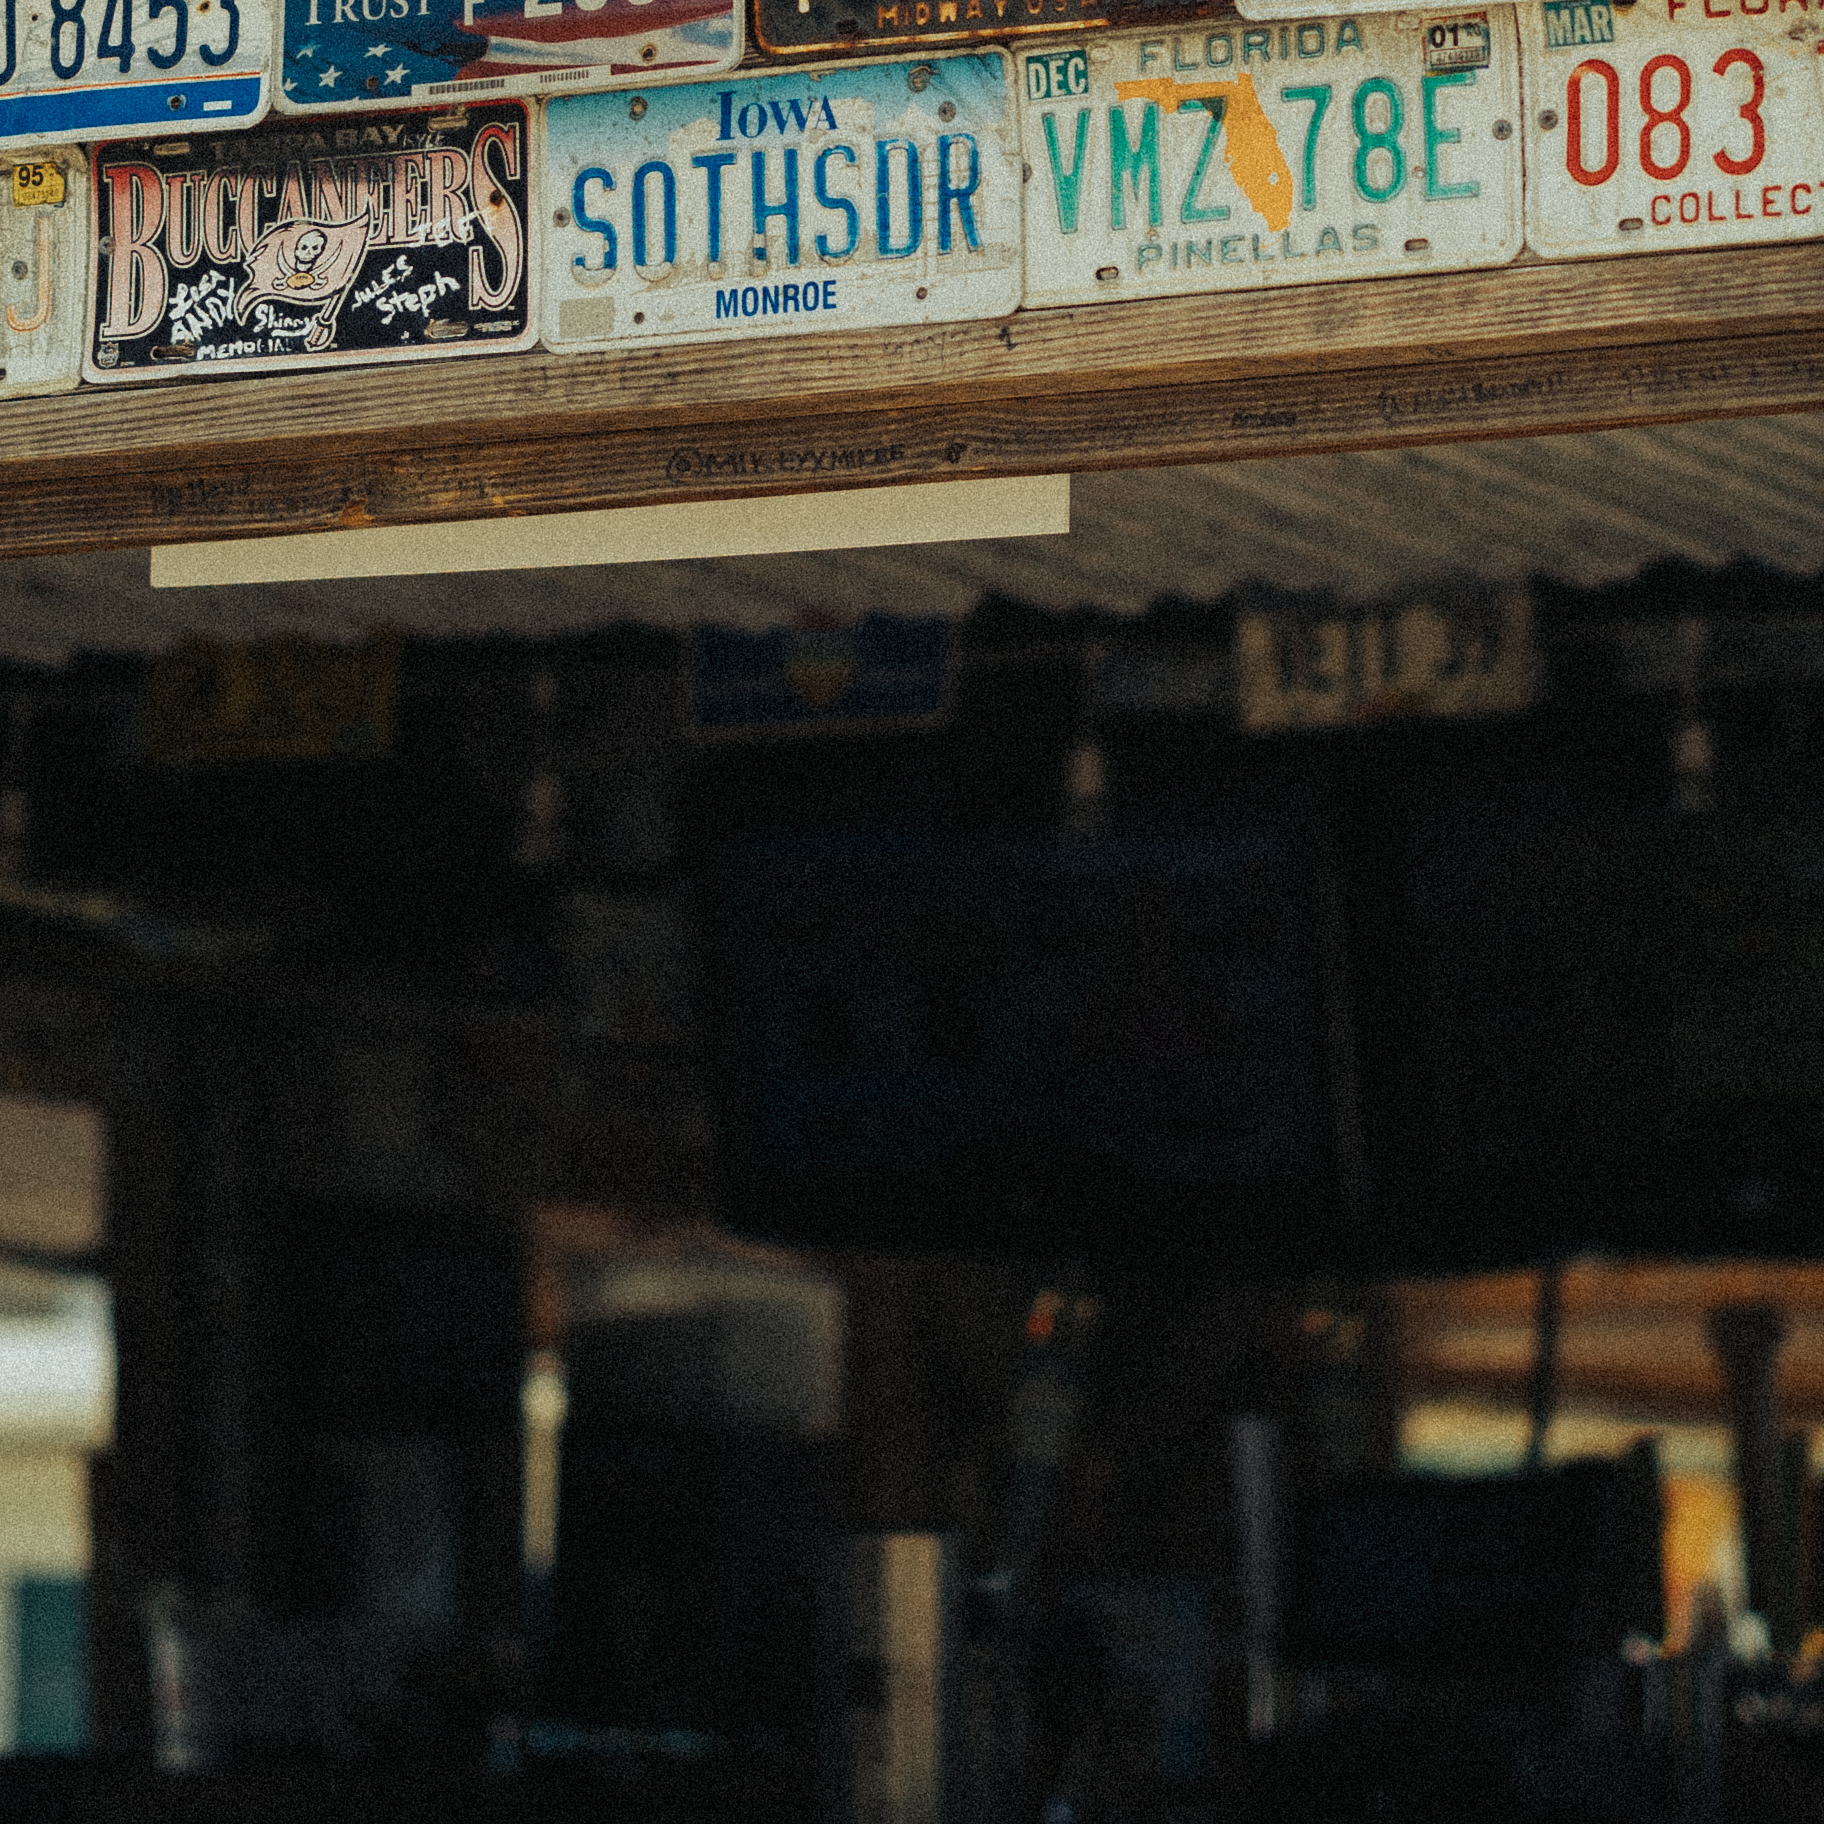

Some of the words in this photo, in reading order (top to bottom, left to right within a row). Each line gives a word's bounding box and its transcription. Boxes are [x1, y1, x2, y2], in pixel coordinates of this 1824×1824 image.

[1138, 21, 1364, 73] FLORIDA
[1545, 4, 1614, 48] MAR
[1028, 56, 1089, 101] DEC
[335, 124, 405, 149] BAY
[1564, 47, 1767, 187] 083
[1041, 97, 1231, 236] VMZ
[102, 122, 524, 341] BUCCANEERS
[1136, 224, 1380, 272] PINELLAS
[713, 280, 839, 321] MONROE
